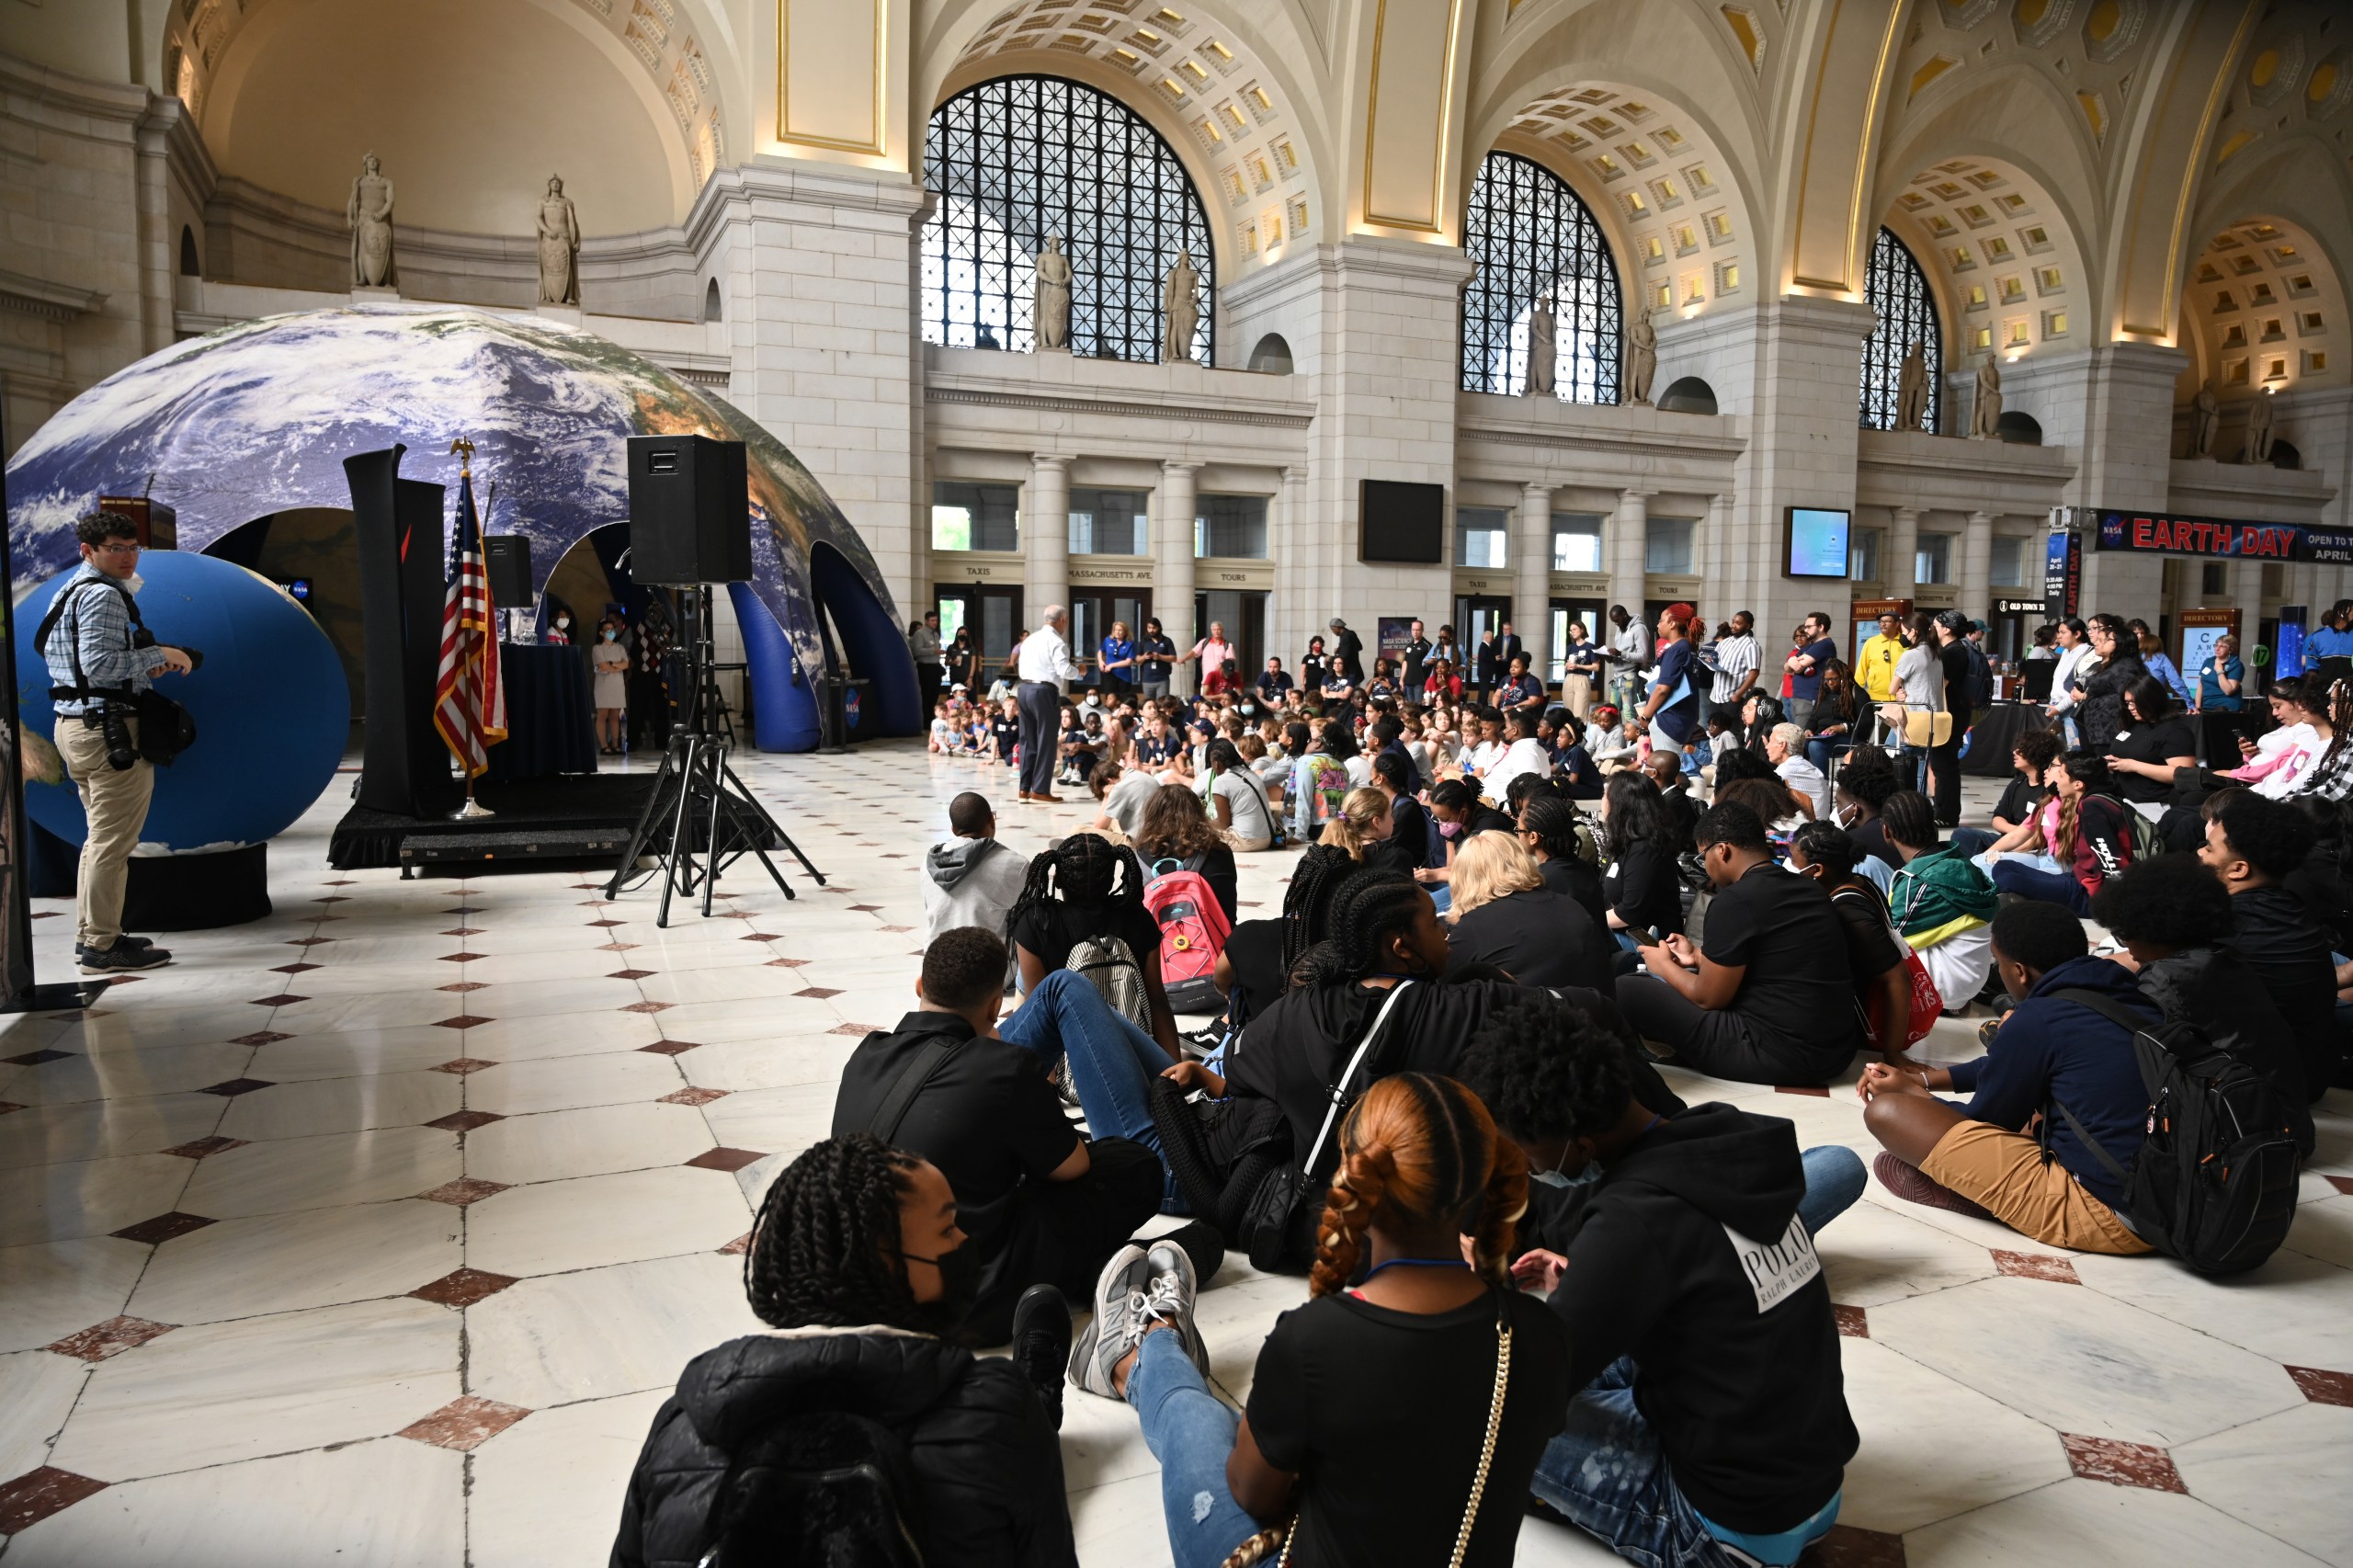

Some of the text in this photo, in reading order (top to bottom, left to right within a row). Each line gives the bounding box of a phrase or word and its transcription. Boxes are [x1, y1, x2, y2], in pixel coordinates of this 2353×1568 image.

[2103, 527, 2122, 535] NASA
[2133, 517, 2295, 557] EARTH DAY
[2308, 534, 2332, 545] OPEN
[2335, 536, 2346, 546] TO
[2069, 548, 2079, 572] DAY
[2315, 550, 2351, 561] APRIL
[966, 566, 991, 576] TAXIS
[1221, 574, 1246, 582] TOURS
[1469, 580, 1487, 588] TAXIS
[1550, 584, 1593, 592] ASSACHUSETTS
[2067, 574, 2078, 614] EARTH
[2009, 602, 2021, 610] OLD
[2022, 603, 2038, 611] TOWN
[2200, 632, 2210, 642] C
[2256, 649, 2268, 663] 17
[1744, 1220, 1810, 1290] POLO
[1760, 1256, 1818, 1305] RALPH LAUREN
